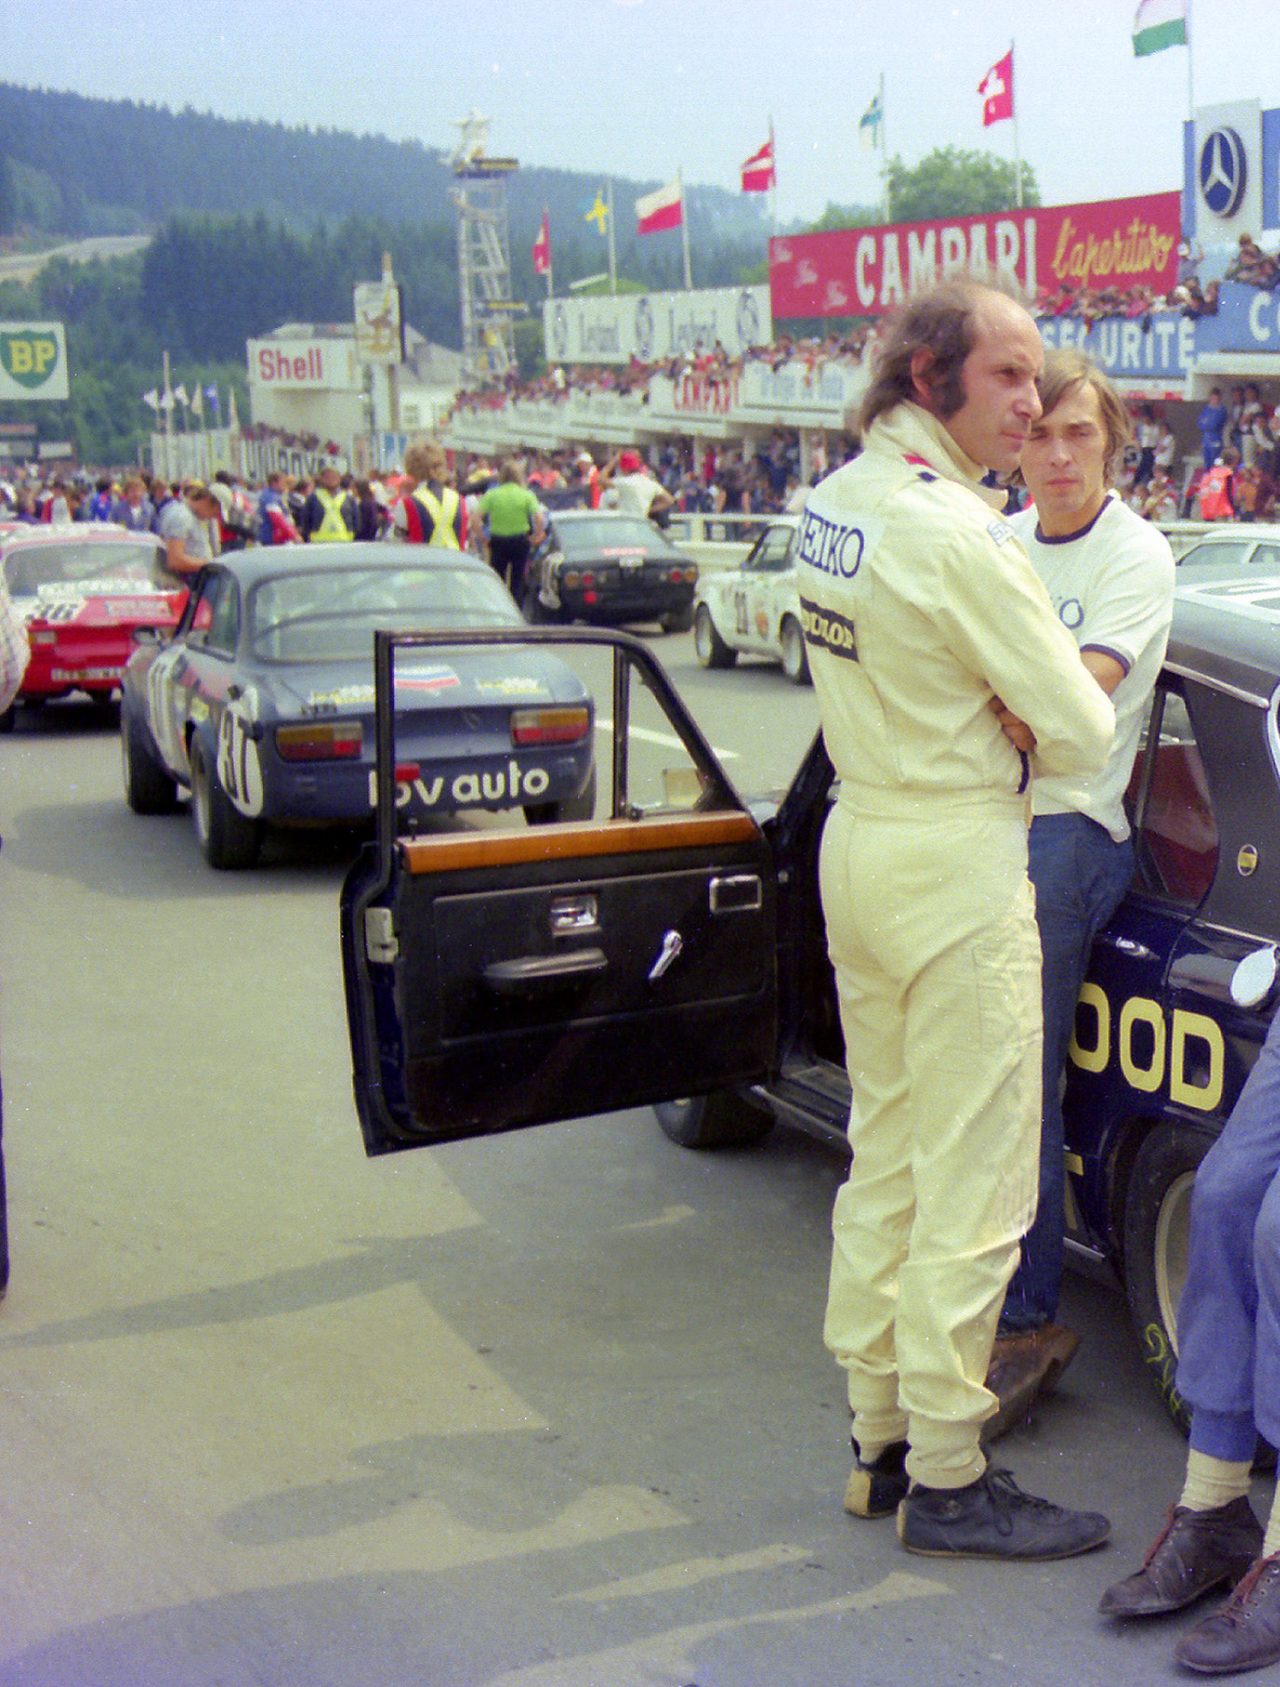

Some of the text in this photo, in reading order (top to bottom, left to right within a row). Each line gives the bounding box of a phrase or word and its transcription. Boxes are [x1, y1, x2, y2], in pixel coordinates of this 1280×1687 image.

[855, 218, 1038, 307] CAMPARI
[9, 339, 57, 374] BP
[258, 349, 323, 381] Shell
[451, 760, 551, 803] auto
